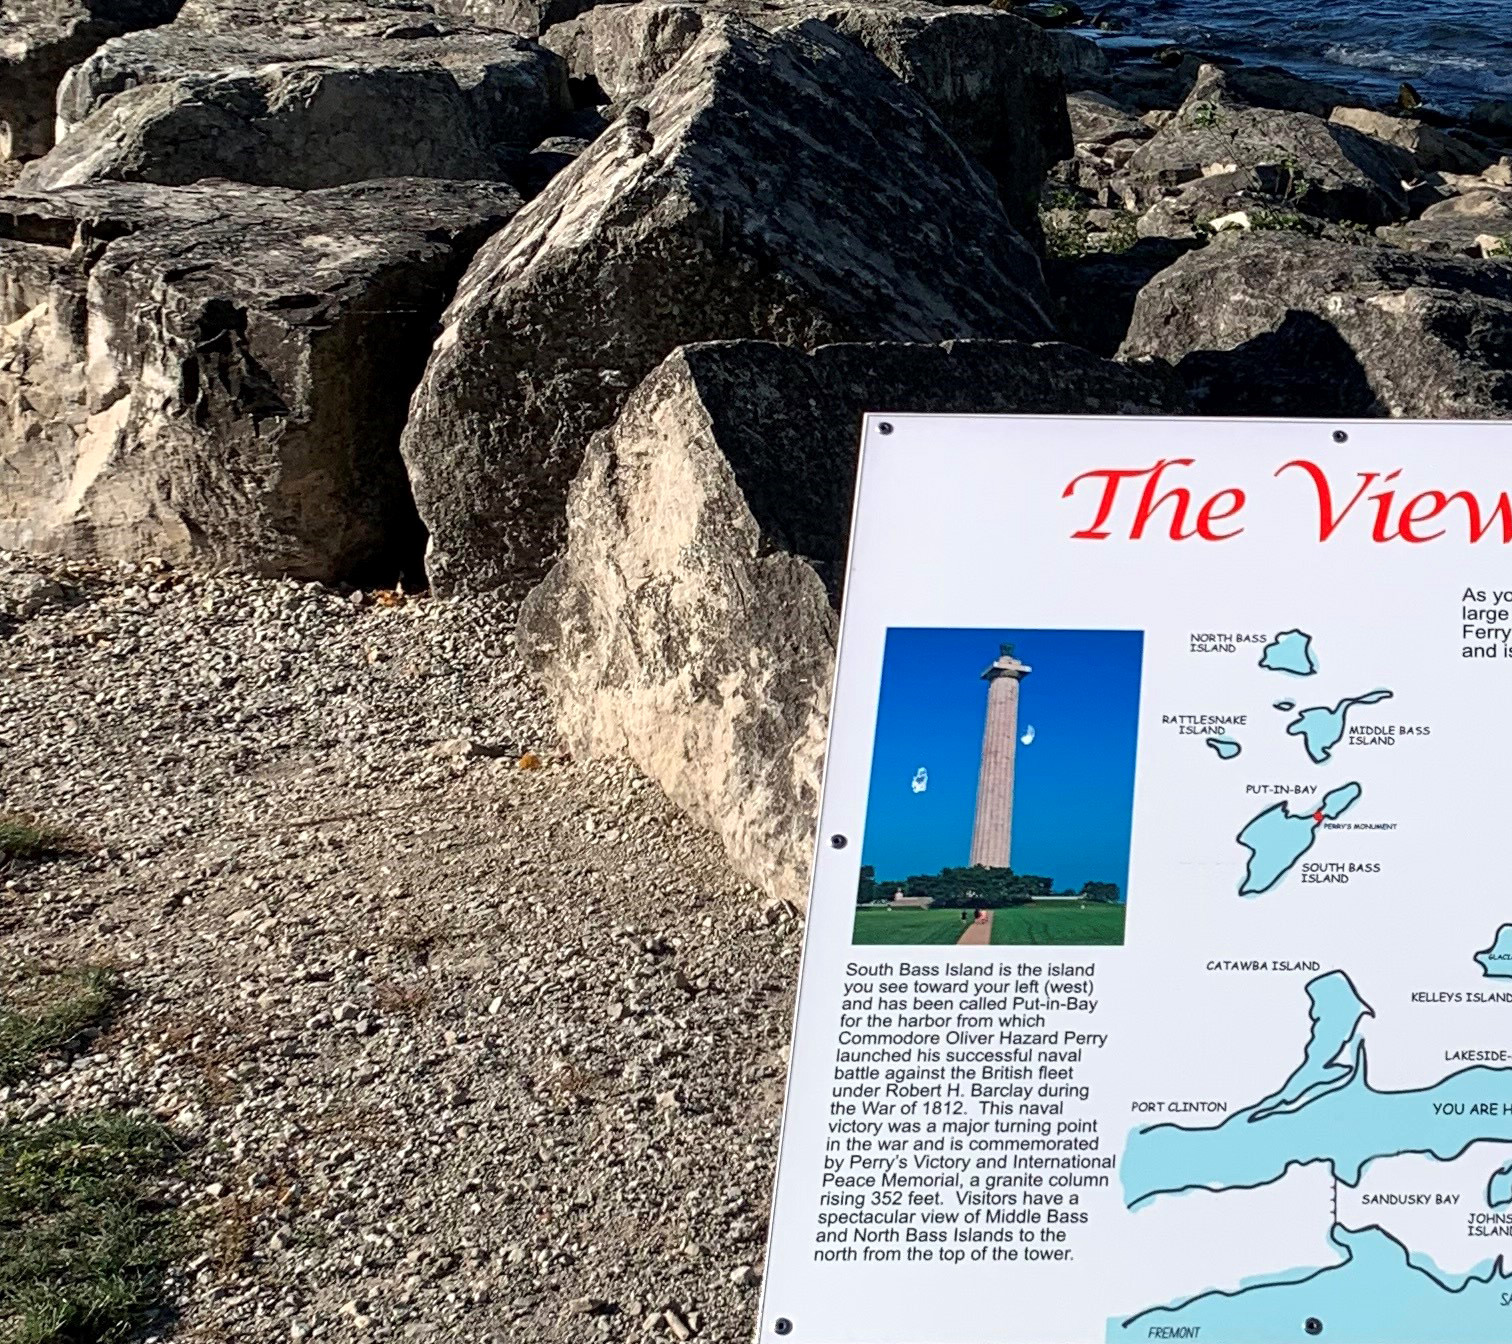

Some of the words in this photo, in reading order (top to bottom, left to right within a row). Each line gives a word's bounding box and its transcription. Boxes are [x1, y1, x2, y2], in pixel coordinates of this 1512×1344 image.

[1061, 458, 1246, 542] The
[1461, 587, 1487, 602] As
[1462, 605, 1509, 625] large
[1191, 633, 1232, 643] NORTH
[1236, 634, 1267, 643] BASS
[1190, 643, 1236, 653] ISLAND
[1162, 715, 1247, 725] RATTLESNAKE
[1179, 726, 1226, 735] ISLAND
[1349, 726, 1395, 736] MIDDLE
[1399, 726, 1431, 736] BASS
[1349, 736, 1395, 746] ISLAND
[1246, 785, 1317, 795] PUT-IN-BAY
[1302, 863, 1345, 872] SOUTH
[1348, 863, 1381, 873] BASS
[1301, 873, 1349, 883] ISLAND
[845, 962, 894, 977] South
[899, 962, 940, 977] Bass
[945, 962, 994, 977] Island
[998, 962, 1012, 977] is
[1017, 962, 1043, 977] the
[1047, 962, 1095, 977] island
[1206, 961, 1268, 971] CATAWBA
[1271, 961, 1320, 971] ISLAND
[1411, 992, 1463, 1003] KELLEYS
[838, 1030, 940, 1045] Commodore
[945, 1030, 995, 1045] Oliver
[999, 1030, 1059, 1045] Hazard
[1064, 1030, 1108, 1049] Perry
[830, 1101, 856, 1116] the
[862, 1101, 897, 1115] War
[900, 1100, 918, 1116] of
[923, 1100, 968, 1115] 1812.
[978, 1100, 1014, 1116] This
[1019, 1100, 1064, 1115] naval
[1131, 1101, 1165, 1113] PORT
[1167, 1101, 1227, 1113] CLINTON
[1433, 1103, 1464, 1116] YOU
[1470, 1103, 1498, 1116] ARE
[824, 1154, 845, 1173] by
[849, 1154, 908, 1173] Perry's
[913, 1154, 971, 1173] Victory
[975, 1154, 1008, 1169] and
[1013, 1154, 1116, 1169] International
[1362, 1194, 1431, 1205] SANDUSKY
[1435, 1194, 1460, 1205] BAY
[1148, 1326, 1200, 1339] FREMONT
